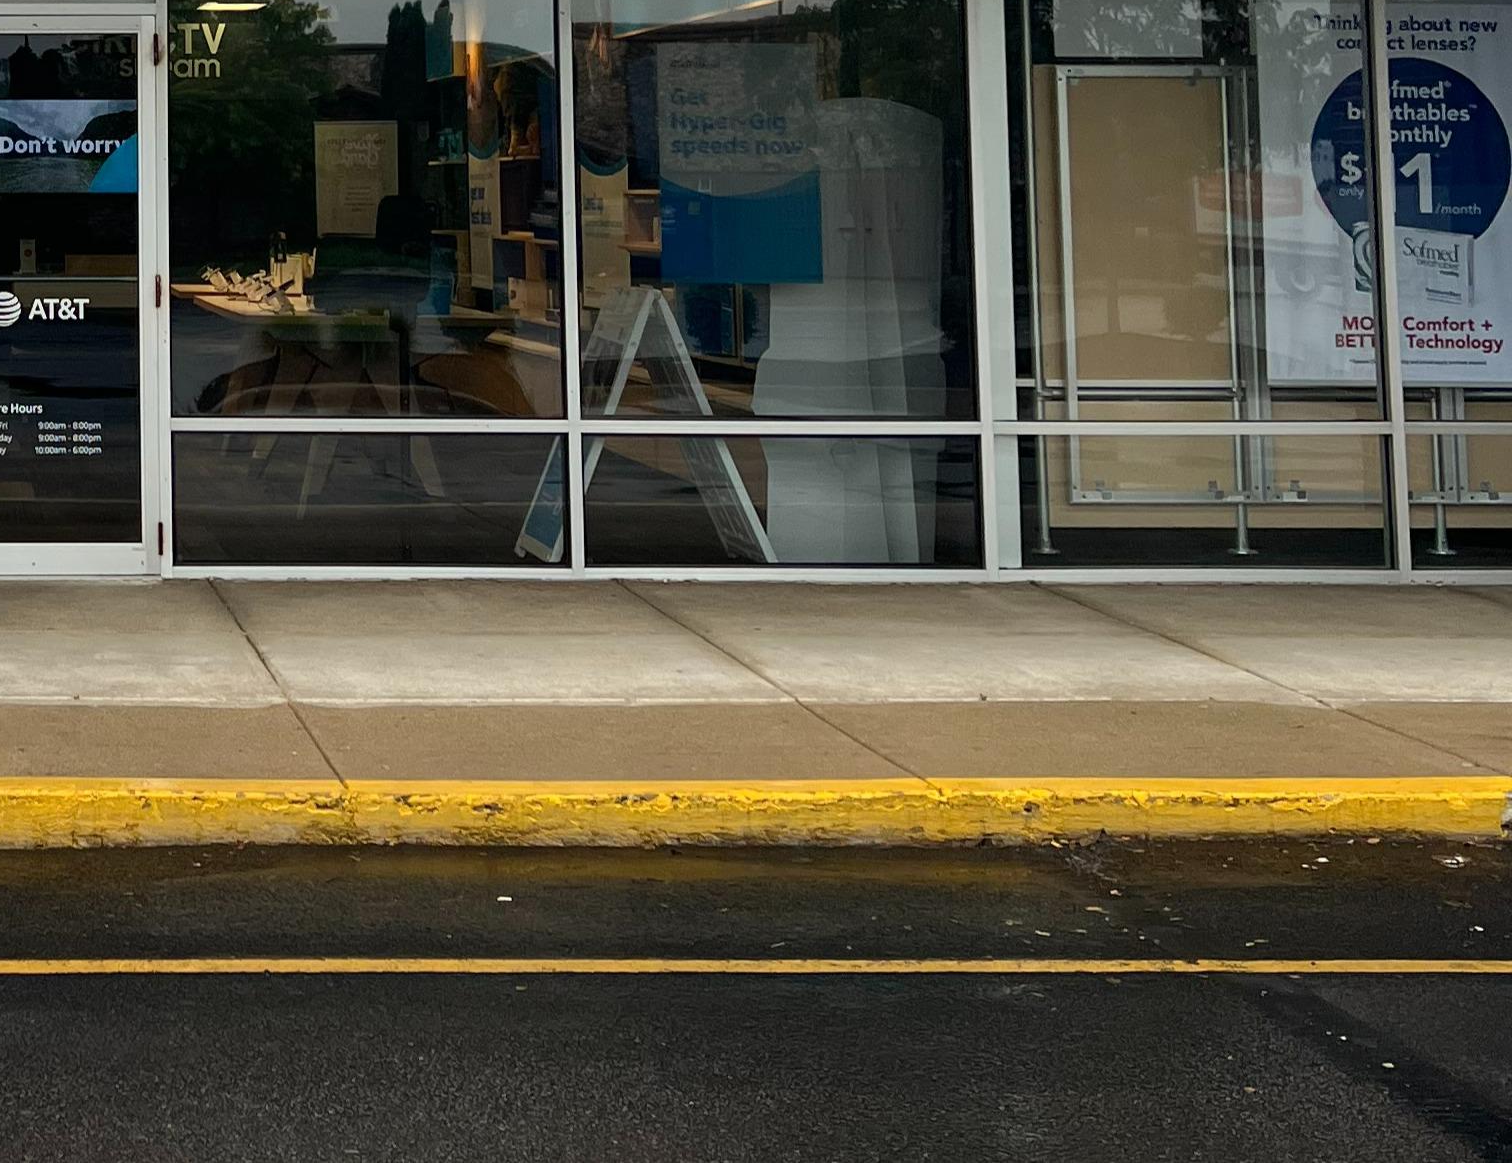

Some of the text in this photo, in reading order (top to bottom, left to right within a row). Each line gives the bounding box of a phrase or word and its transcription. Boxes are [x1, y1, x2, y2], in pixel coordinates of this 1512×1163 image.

[1399, 16, 1452, 32] about
[1459, 20, 1497, 33] new
[1411, 36, 1476, 51] lenses?
[671, 137, 804, 157] speeds now
[1338, 186, 1364, 199] only
[1402, 237, 1460, 262] Sofmed
[28, 298, 90, 320] AT&T
[1343, 316, 1374, 331] MO
[1403, 316, 1475, 331] Comfort
[1335, 333, 1504, 353] BETT Technology
[10, 403, 43, 414] Hours
